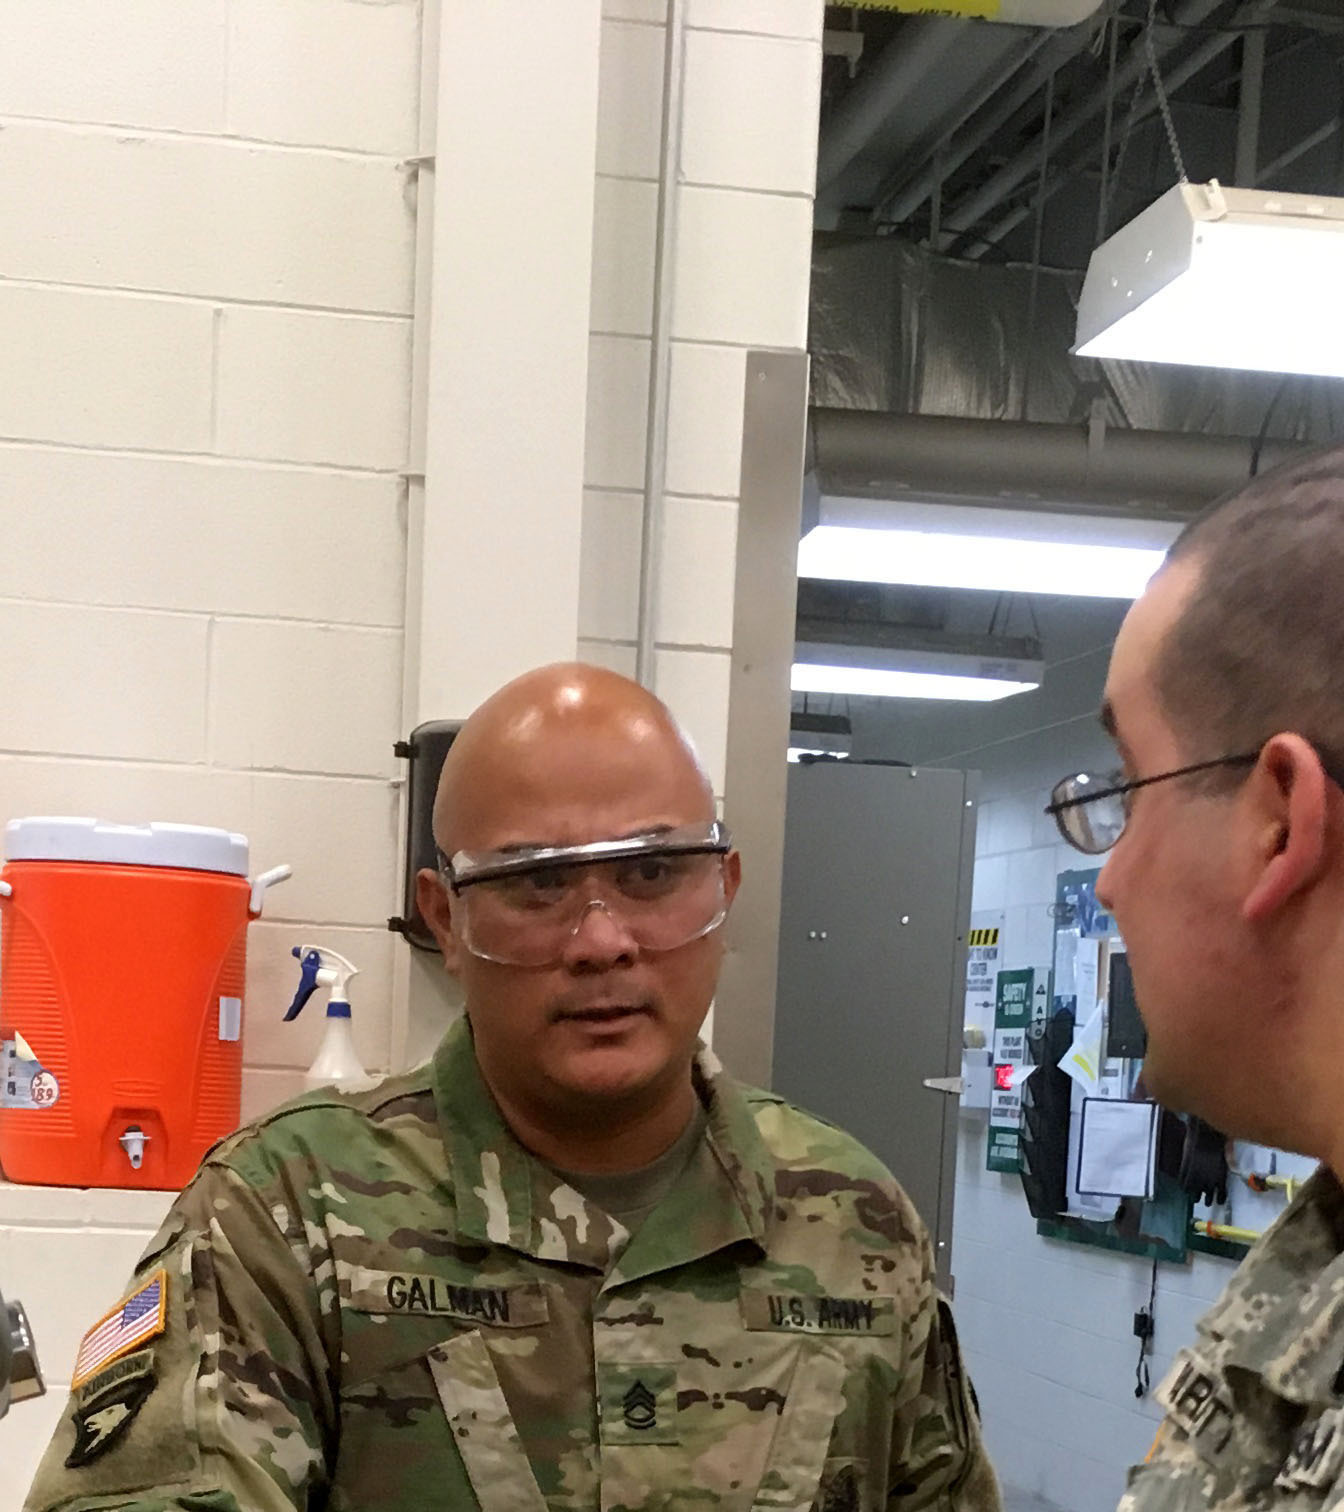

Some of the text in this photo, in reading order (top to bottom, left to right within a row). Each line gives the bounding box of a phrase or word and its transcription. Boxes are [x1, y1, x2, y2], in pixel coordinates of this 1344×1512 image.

[387, 1276, 510, 1323] GALMAN
[768, 1295, 873, 1330] U.S. ARMY
